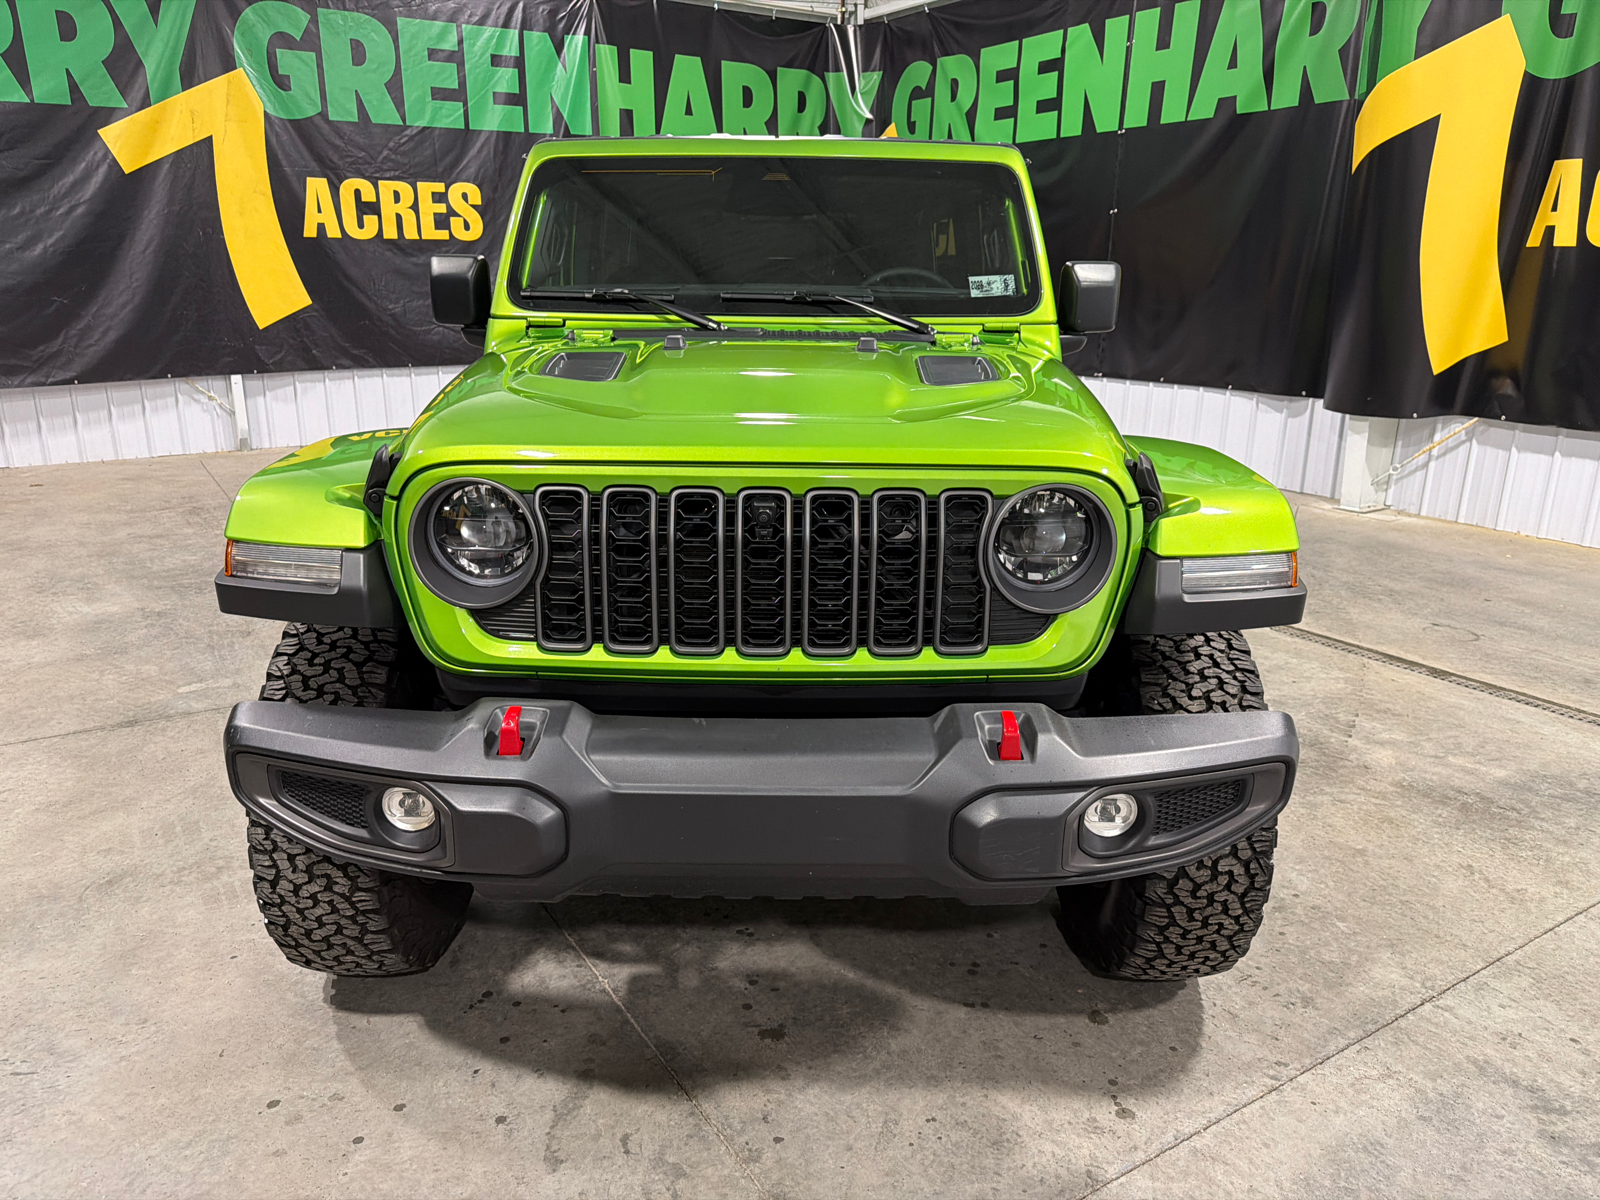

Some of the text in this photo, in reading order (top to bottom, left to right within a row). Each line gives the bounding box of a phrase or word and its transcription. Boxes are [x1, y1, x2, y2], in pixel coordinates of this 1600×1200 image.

[0, 0, 593, 136] RY GREEN
[595, 15, 1130, 143] HARRY GREEN
[1123, 0, 1433, 129] HARY
[97, 67, 312, 329] 7
[303, 177, 484, 241] ACRES
[1352, 13, 1526, 376] 7
[1526, 158, 1600, 247] A
